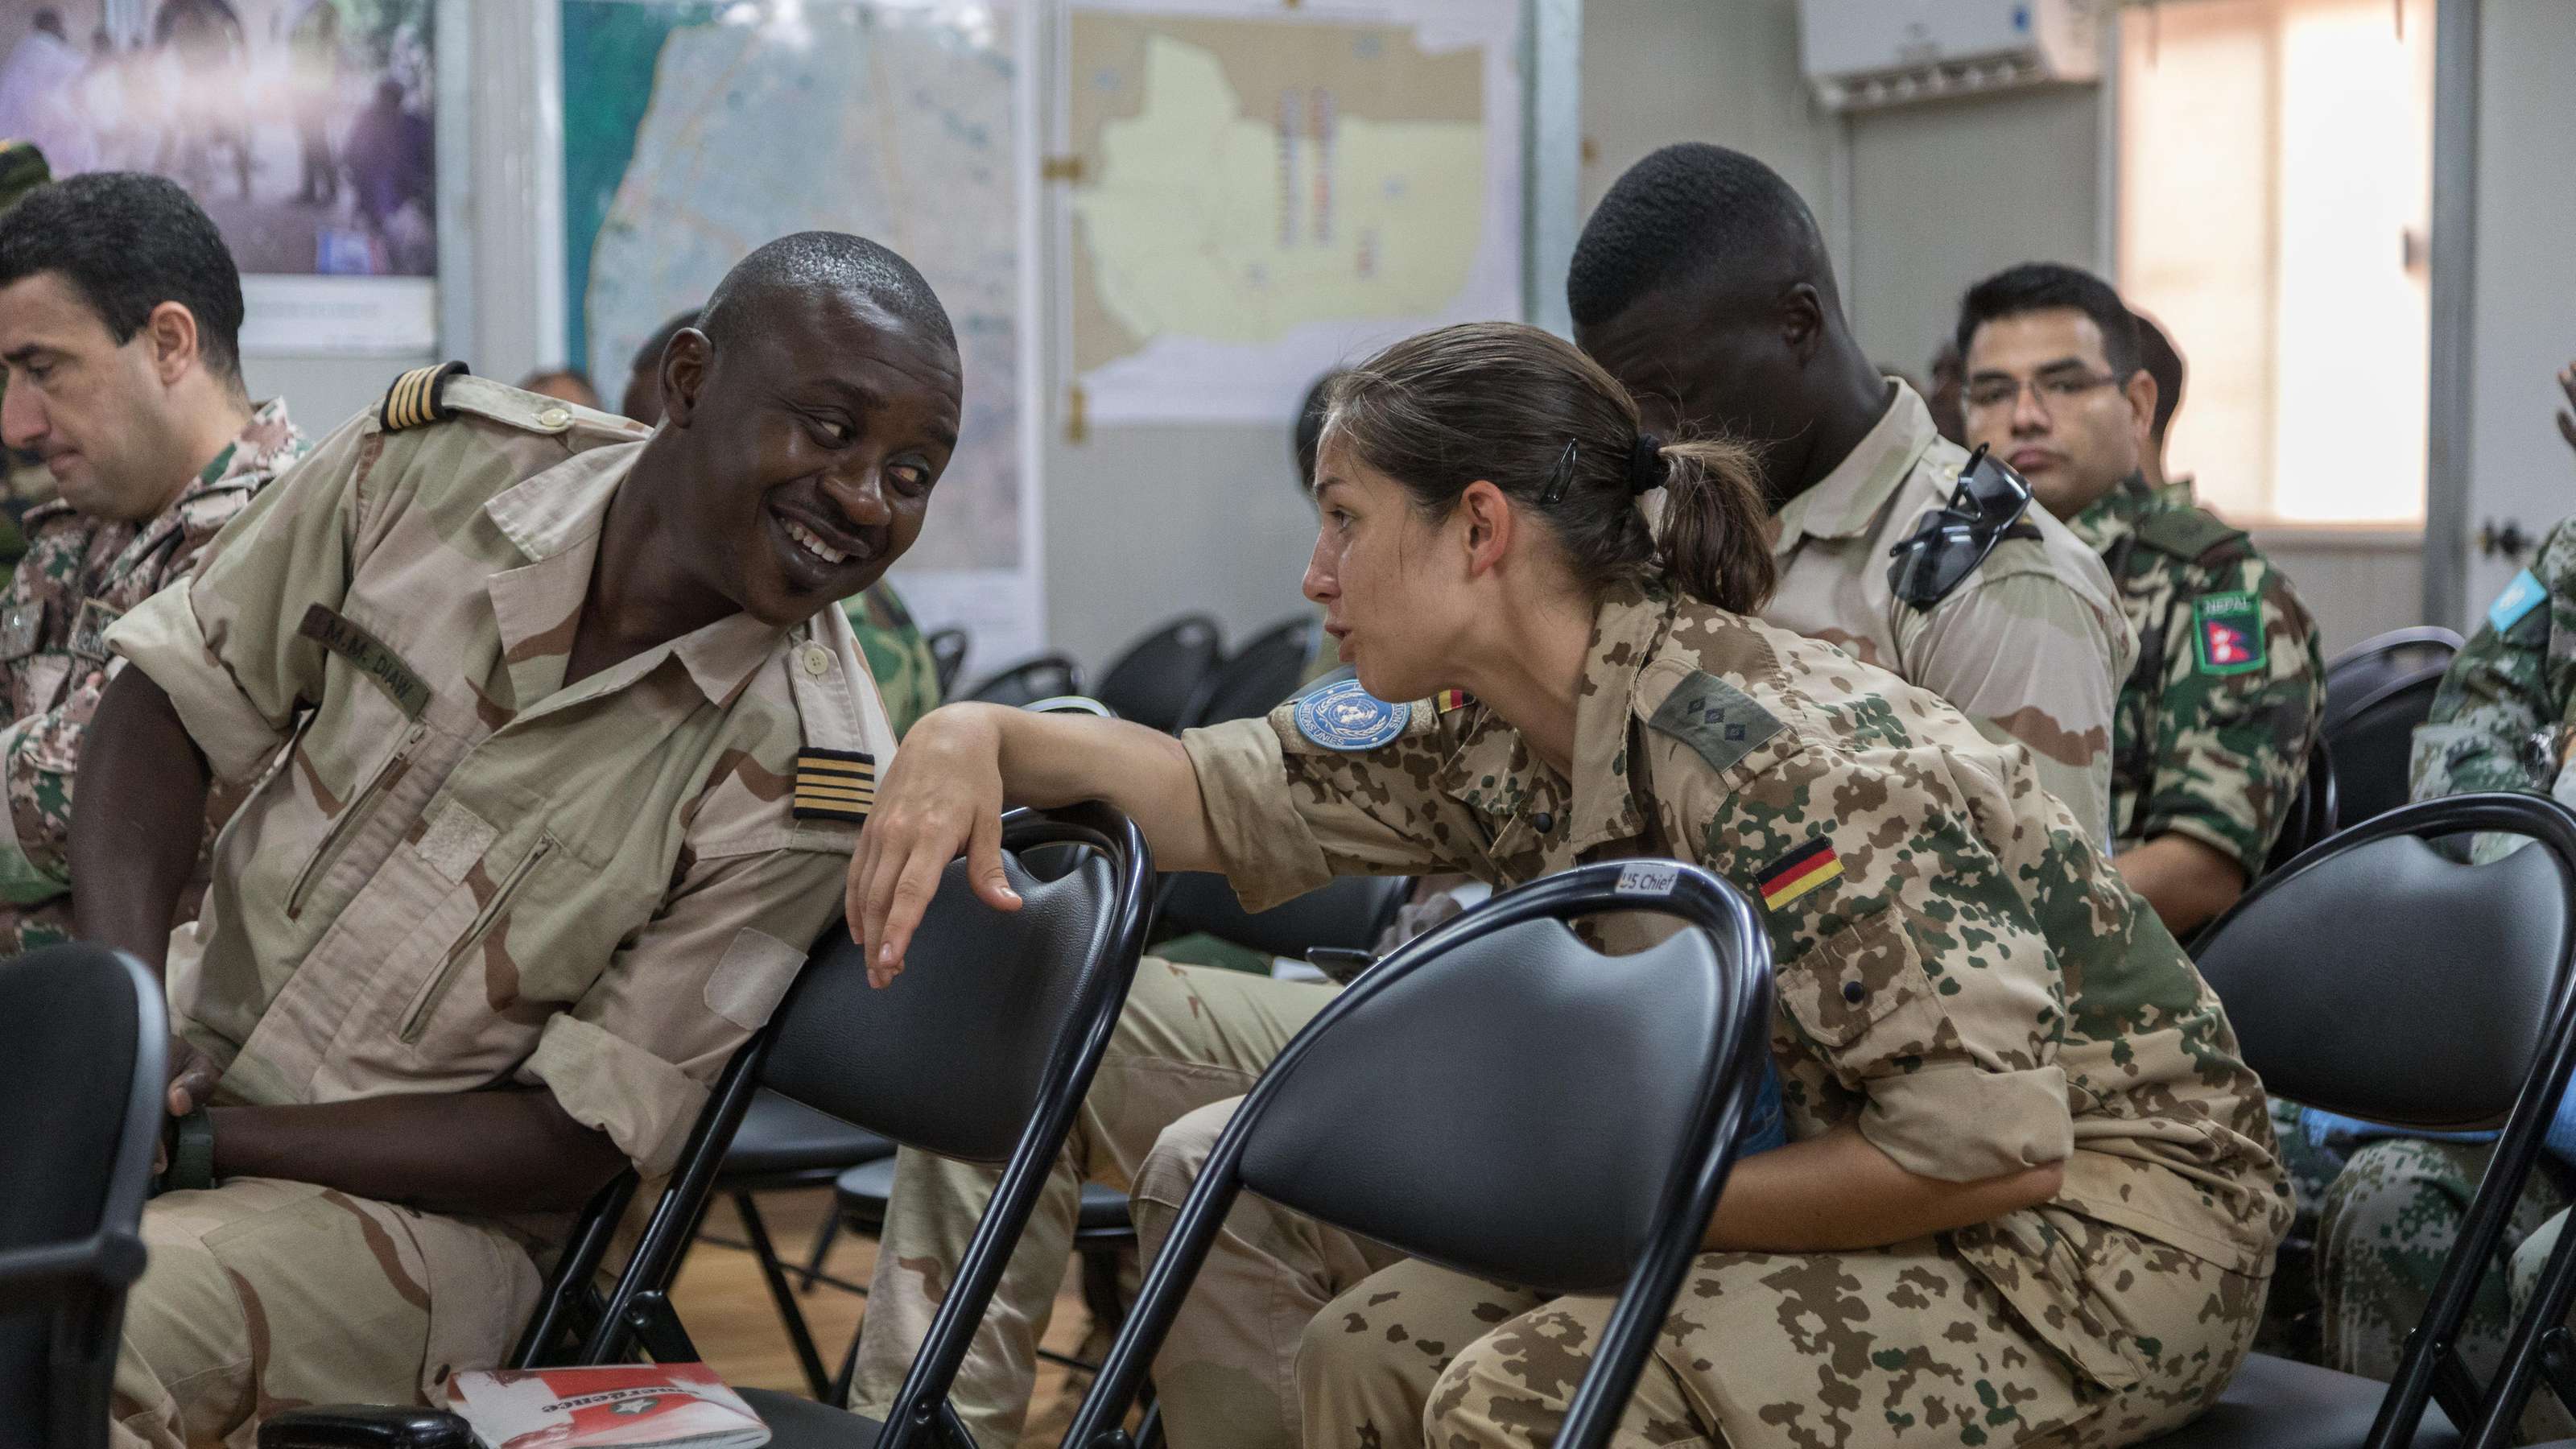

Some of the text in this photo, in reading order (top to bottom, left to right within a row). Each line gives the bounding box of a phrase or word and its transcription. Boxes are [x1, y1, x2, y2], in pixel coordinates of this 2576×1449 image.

[2205, 597, 2251, 613] NEPAL
[1313, 729, 1344, 745] UNIES
[1640, 873, 1675, 890] Chief
